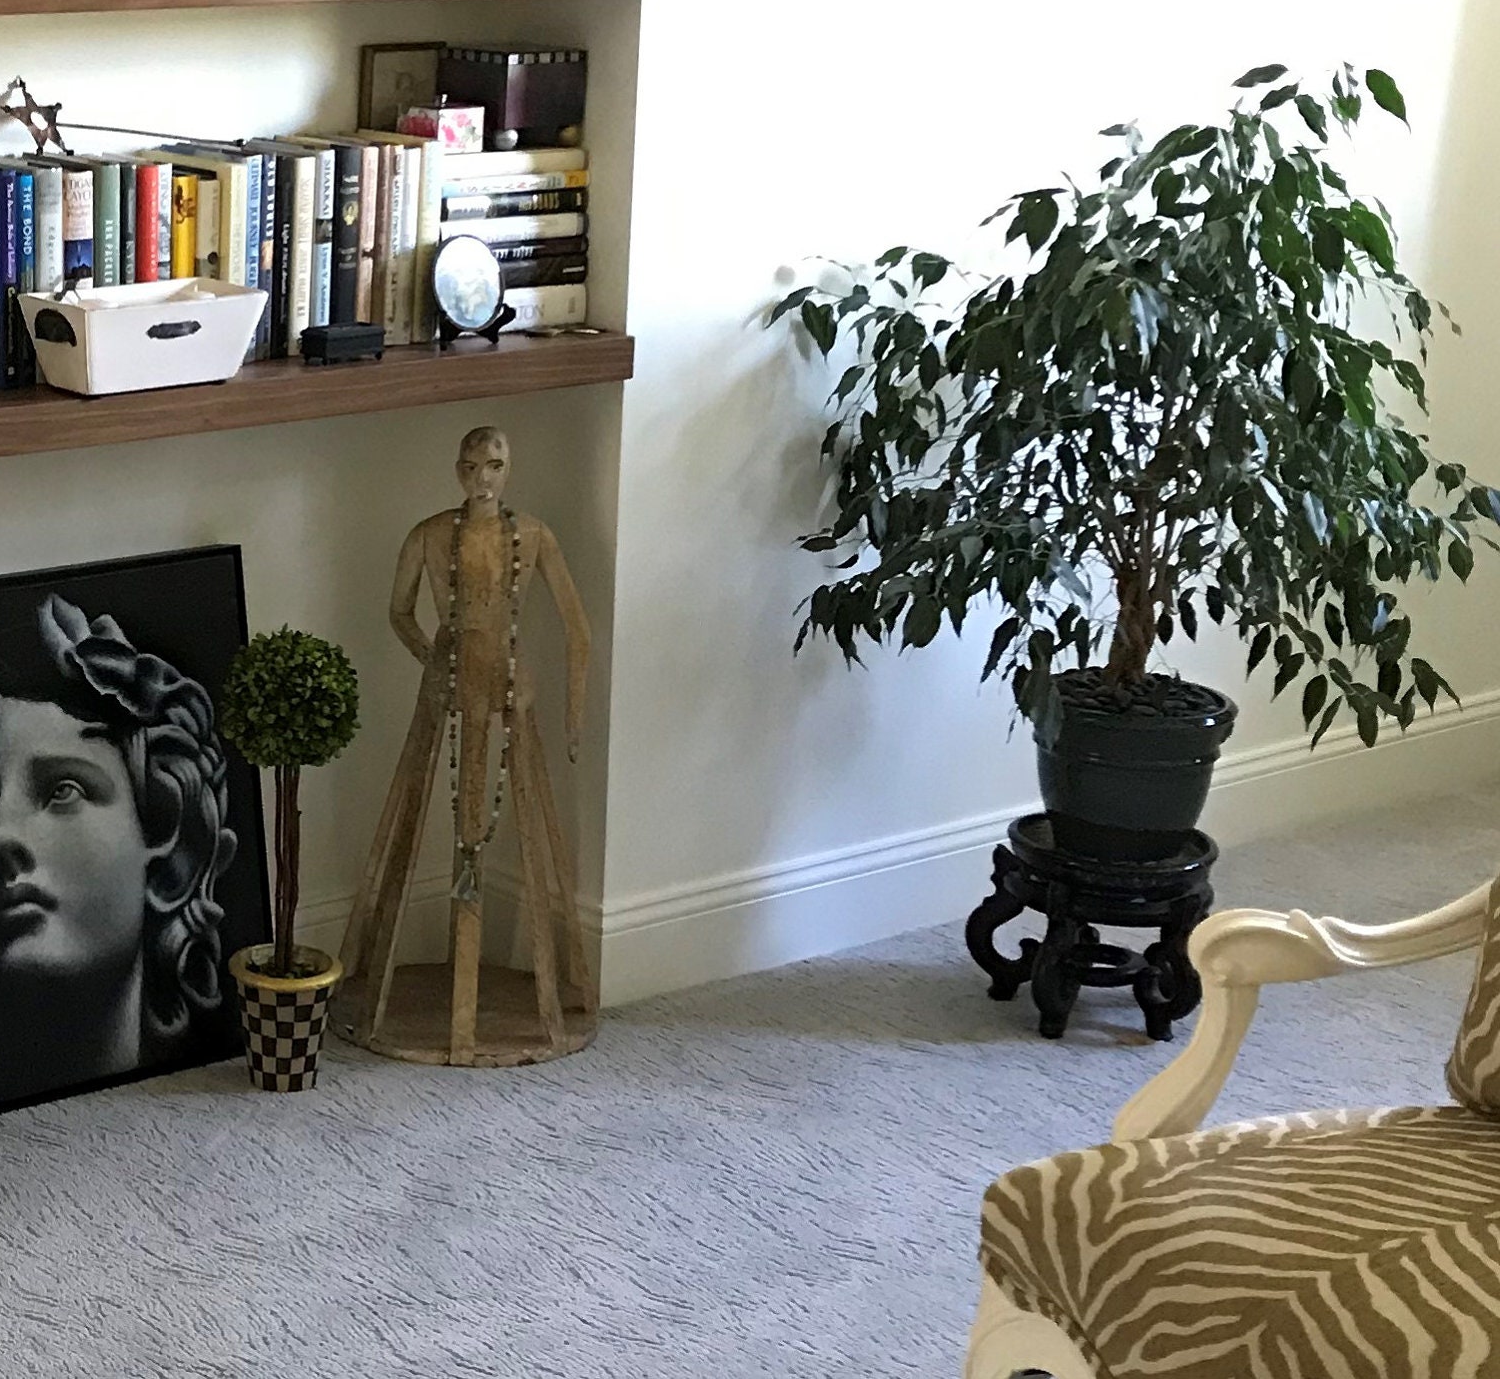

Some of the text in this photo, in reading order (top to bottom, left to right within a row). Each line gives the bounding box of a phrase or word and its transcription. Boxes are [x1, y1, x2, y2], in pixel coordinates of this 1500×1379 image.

[22, 185, 32, 255] THE BOND
[249, 207, 259, 249] JOURNEY
[104, 244, 113, 283] PACKER
